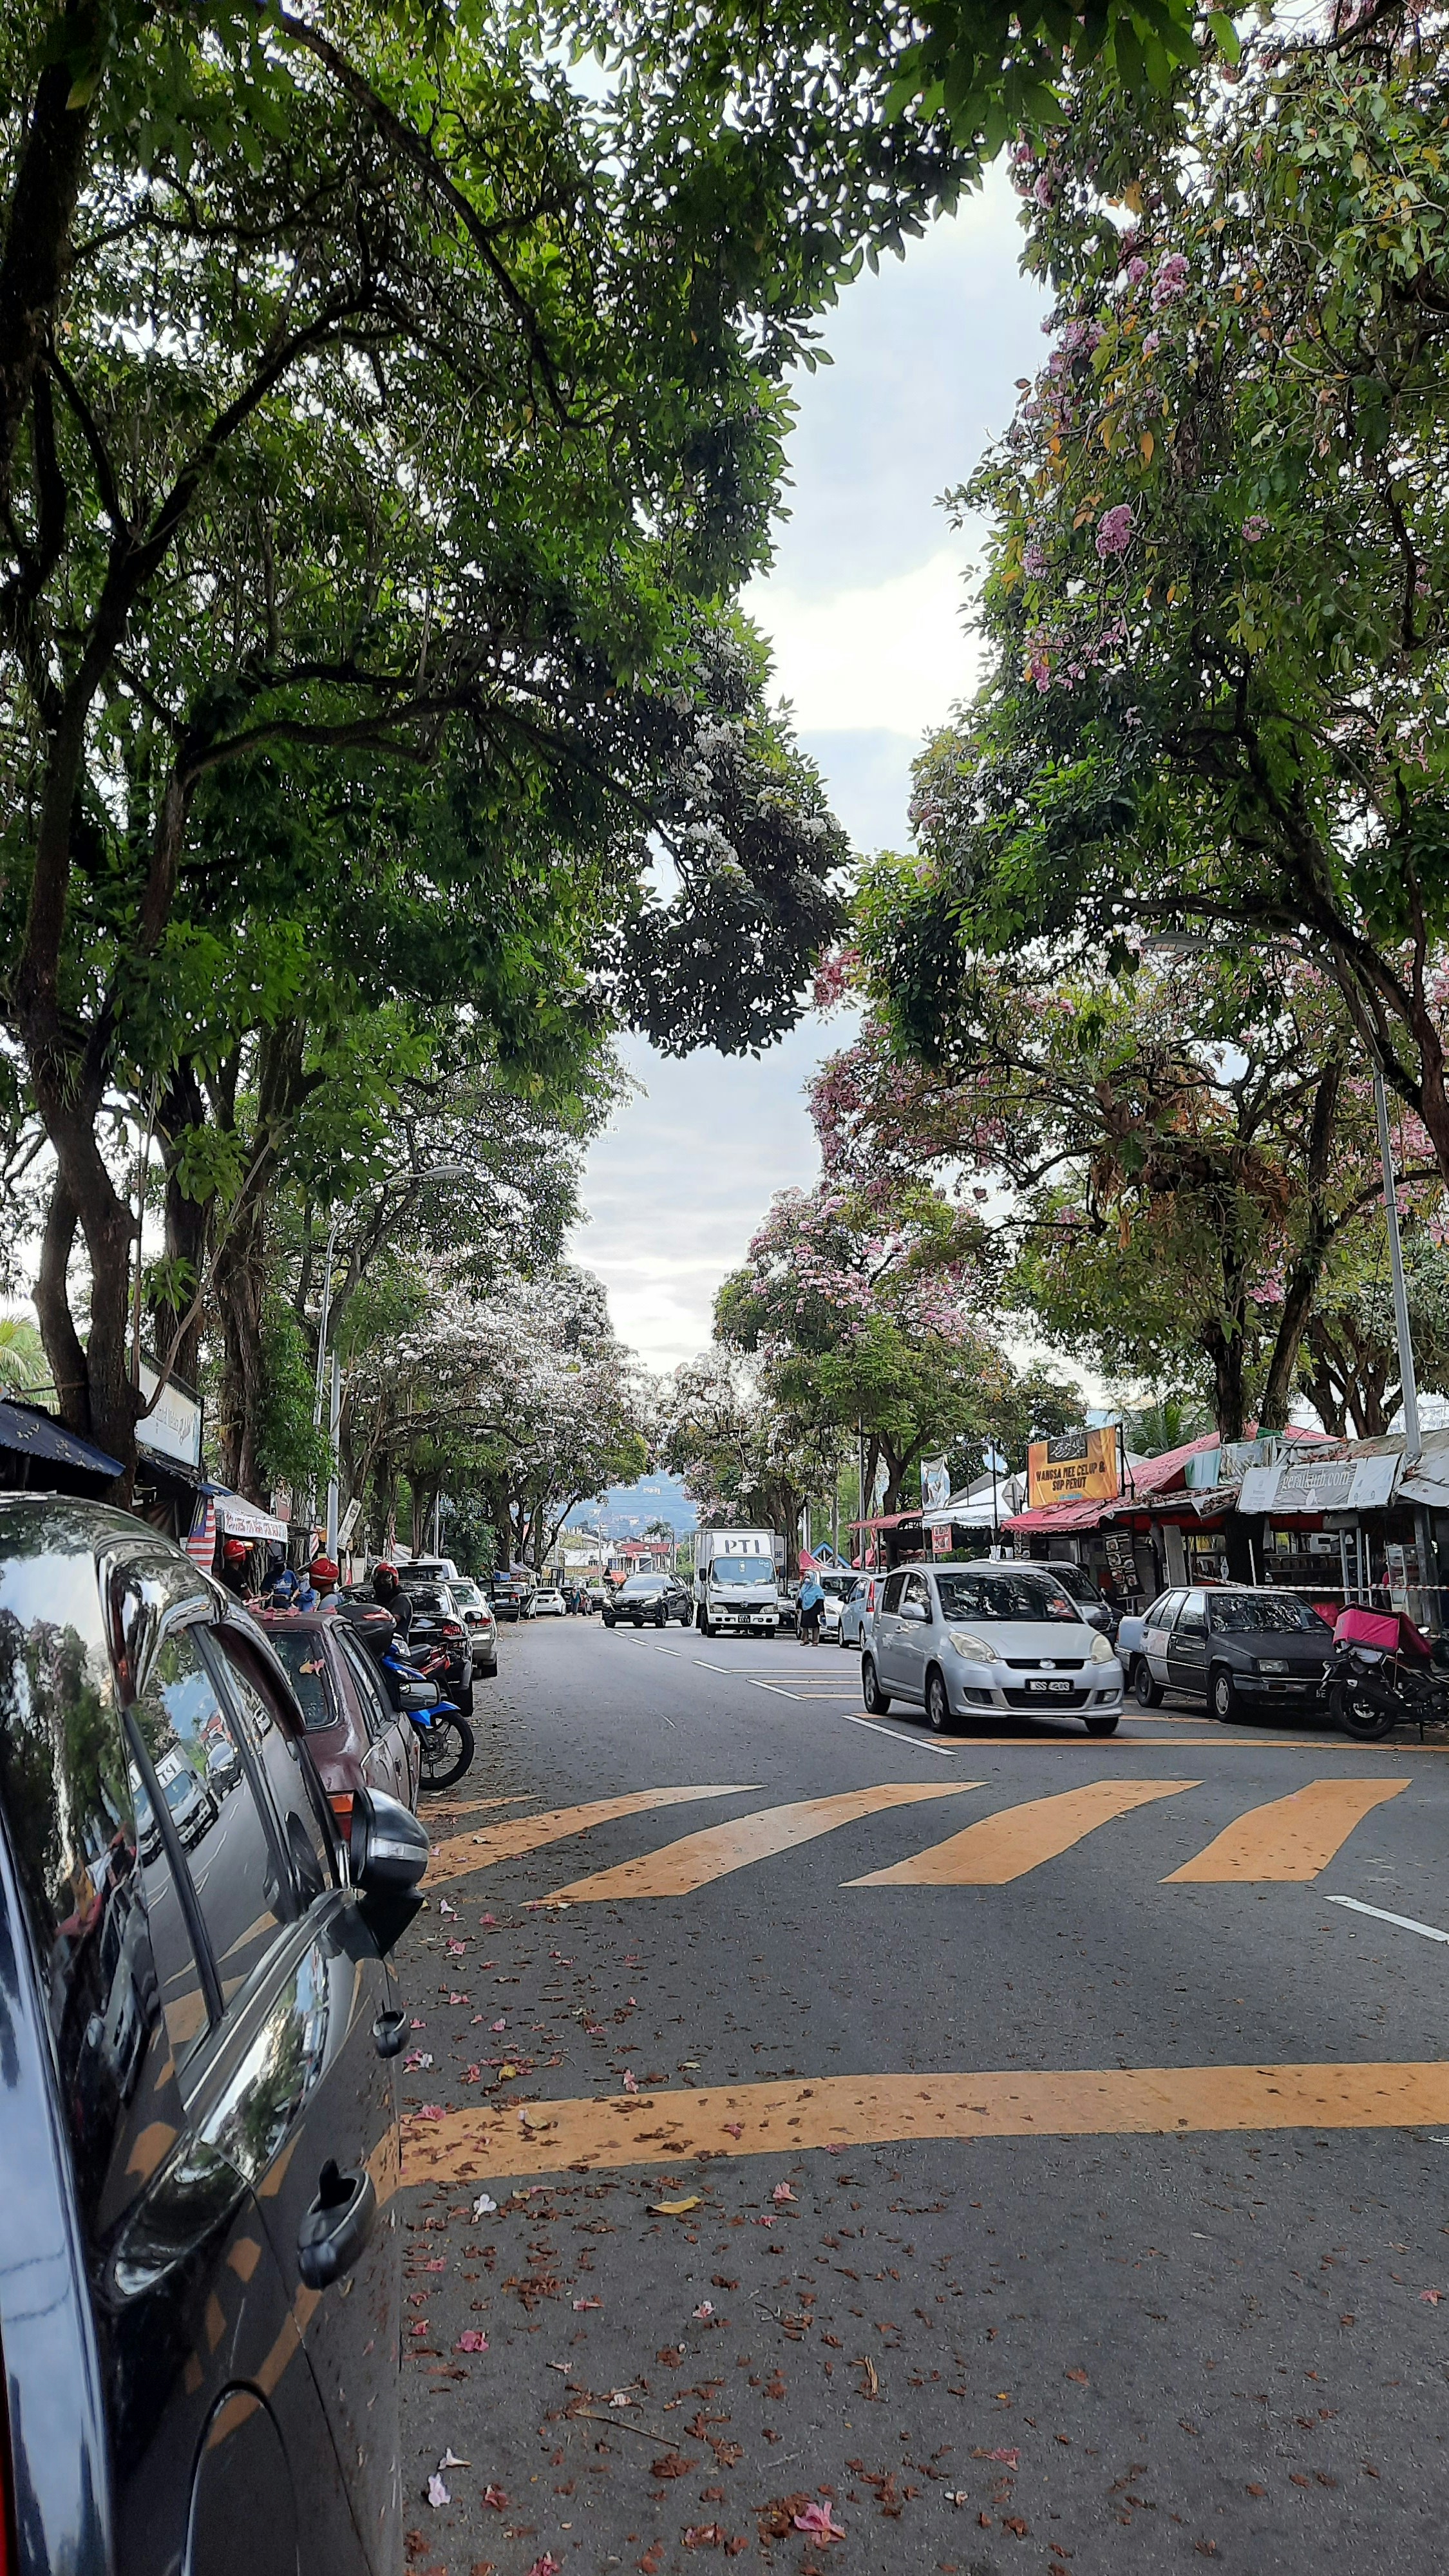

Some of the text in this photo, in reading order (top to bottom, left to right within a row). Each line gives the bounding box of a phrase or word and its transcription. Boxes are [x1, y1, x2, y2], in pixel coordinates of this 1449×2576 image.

[1036, 1469, 1061, 1481] WANGSA
[1063, 1466, 1075, 1478] MEE
[1077, 1463, 1097, 1476] CELUP
[1066, 1477, 1086, 1490] PERUT
[724, 1540, 760, 1553] PTI
